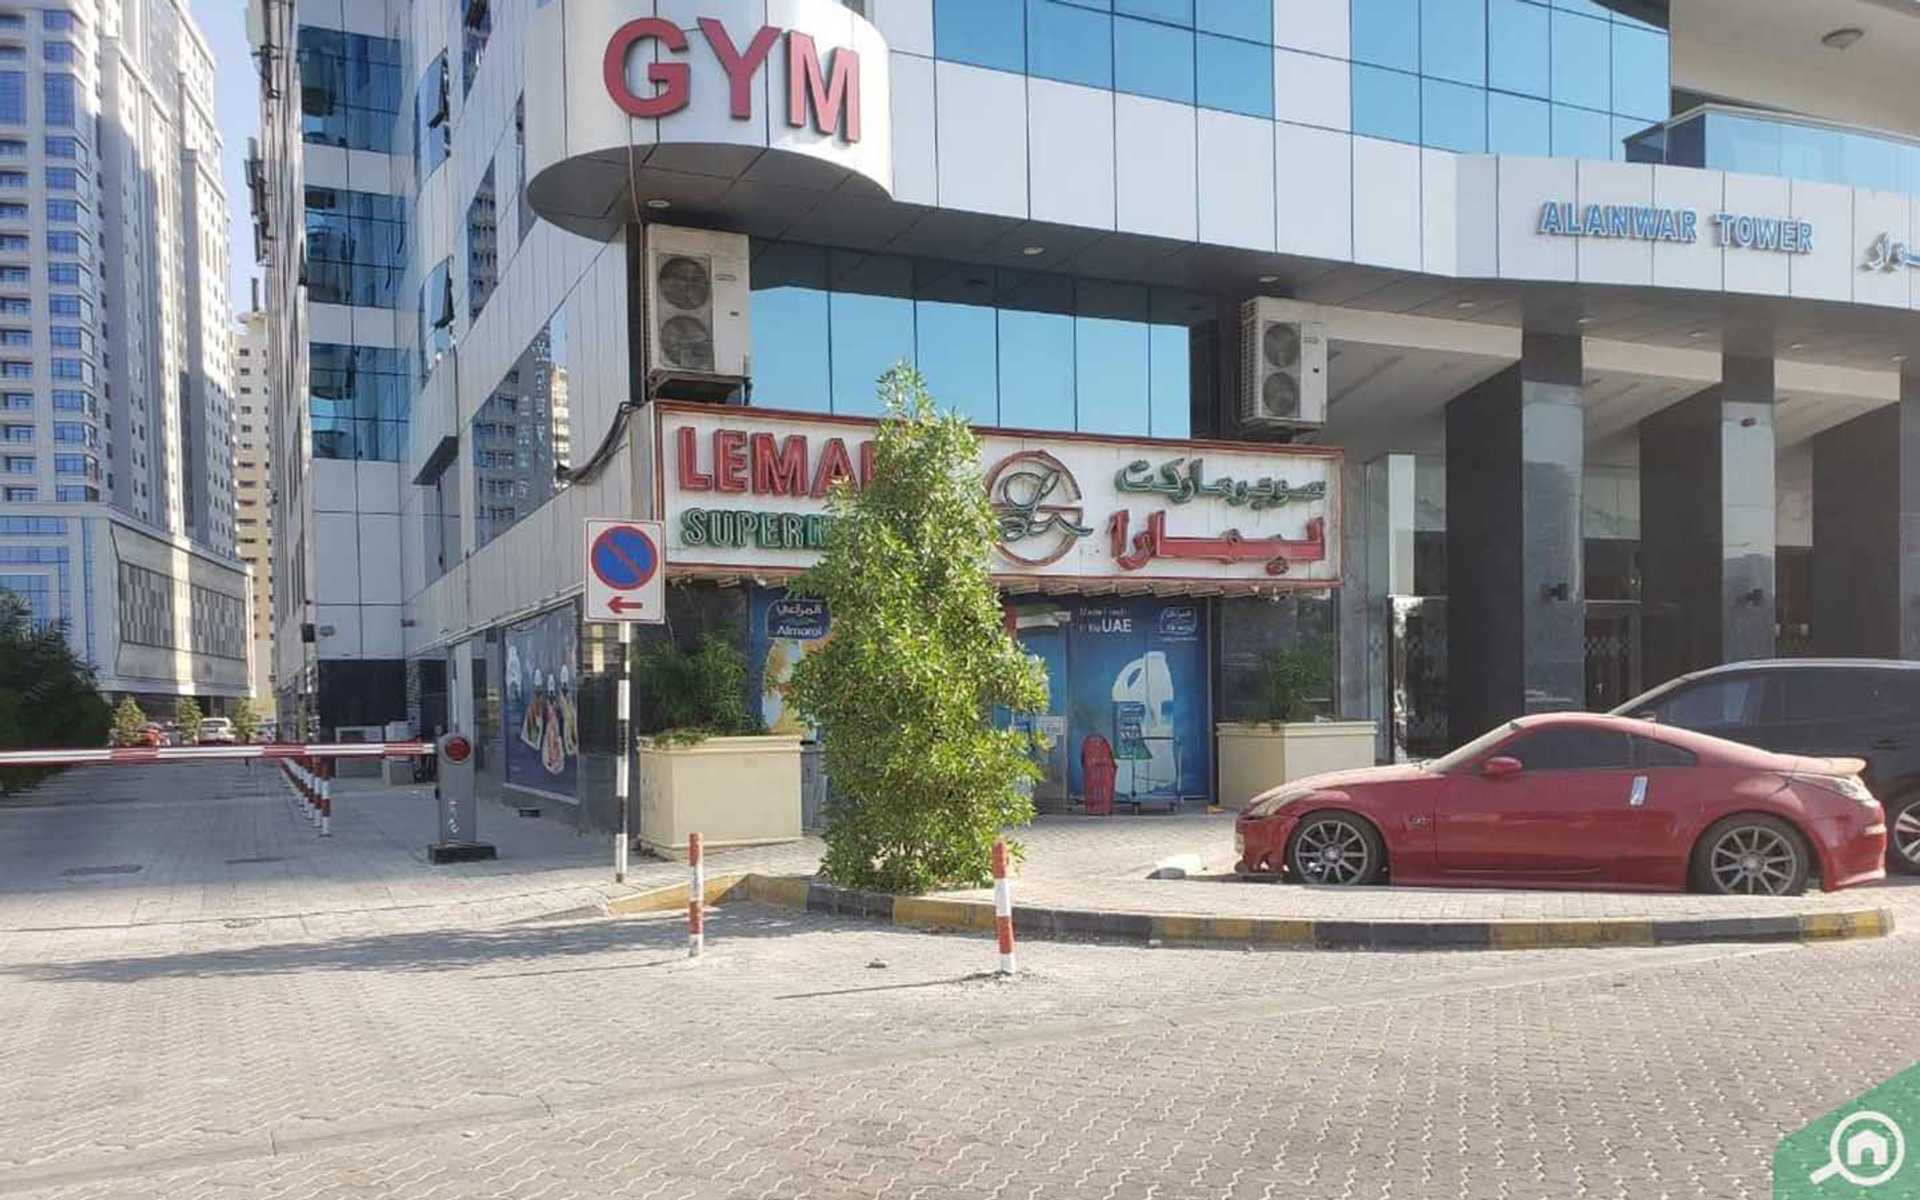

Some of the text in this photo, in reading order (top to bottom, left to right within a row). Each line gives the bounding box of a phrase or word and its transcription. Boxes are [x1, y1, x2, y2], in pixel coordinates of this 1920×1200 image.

[603, 17, 860, 143] GYM
[1538, 201, 1813, 254] ALANWAR TOWER
[1101, 618, 1133, 633] UAE
